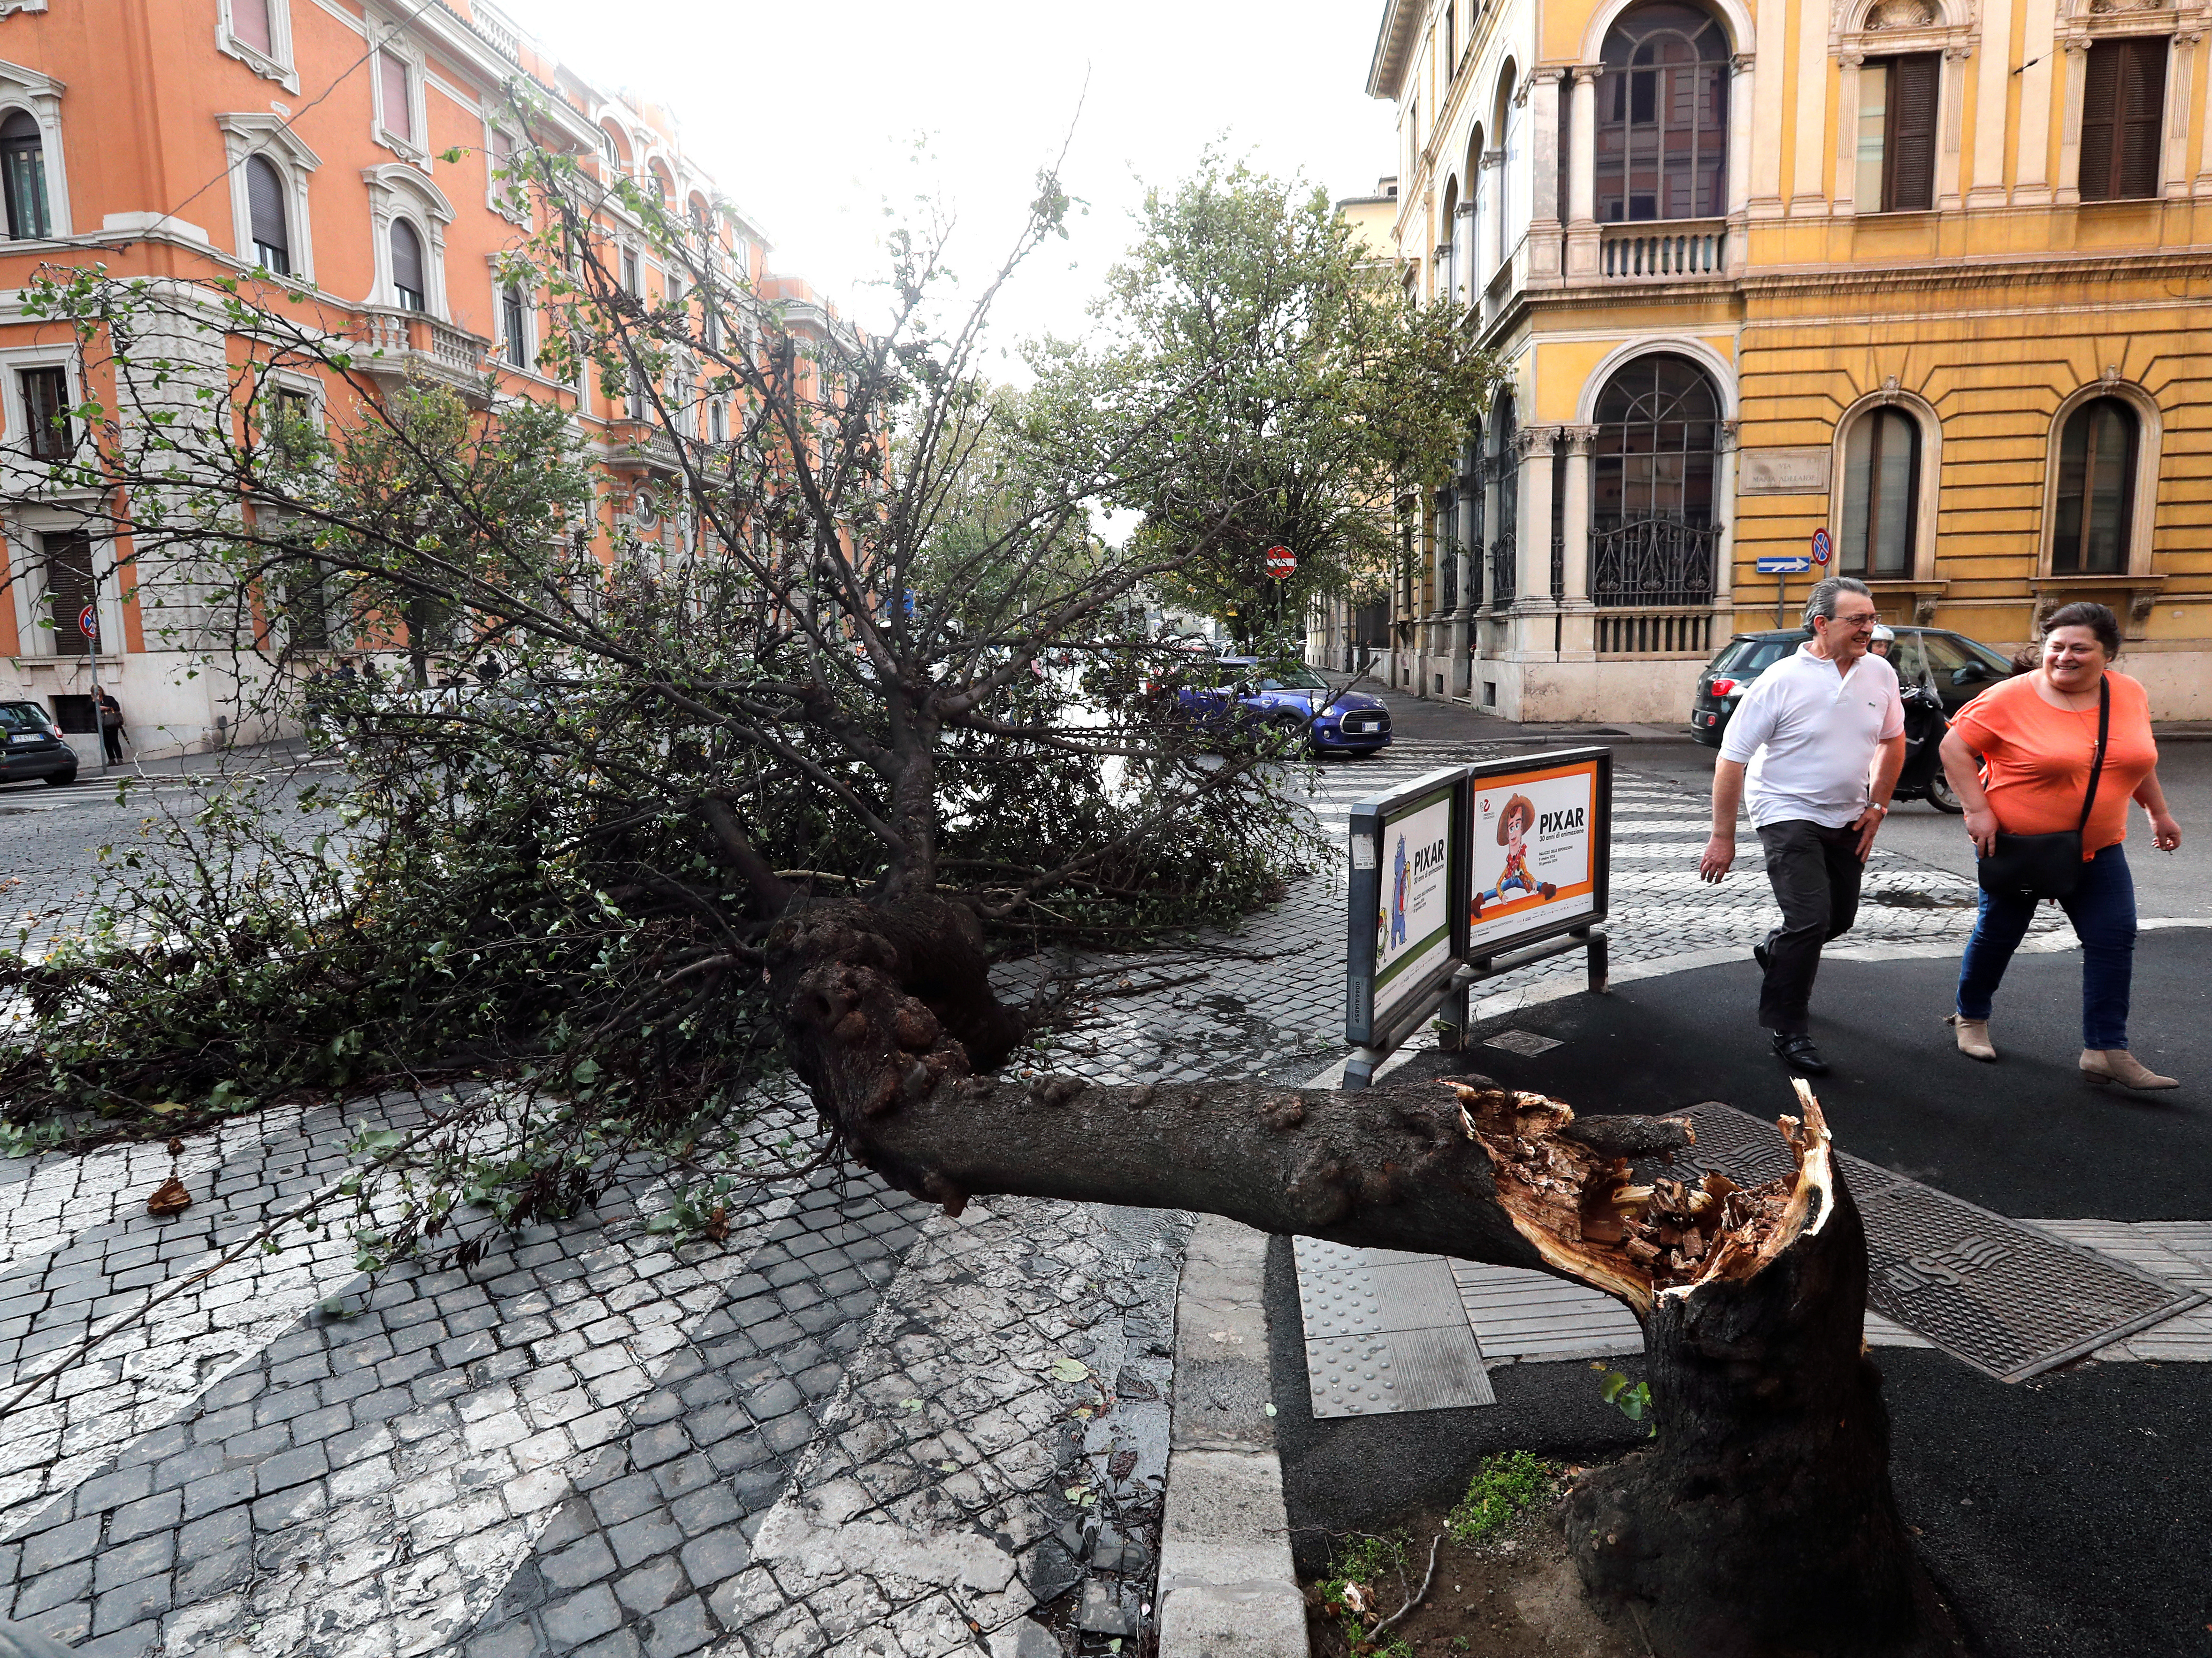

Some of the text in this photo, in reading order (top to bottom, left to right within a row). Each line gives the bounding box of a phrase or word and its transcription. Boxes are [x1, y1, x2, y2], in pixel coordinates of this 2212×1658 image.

[1539, 807, 1584, 834] PIXAR
[1561, 829, 1584, 837] animazione
[1414, 839, 1444, 876] PIXAR
[1428, 863, 1444, 876] animazione
[1883, 1256, 1960, 1291] SIP
